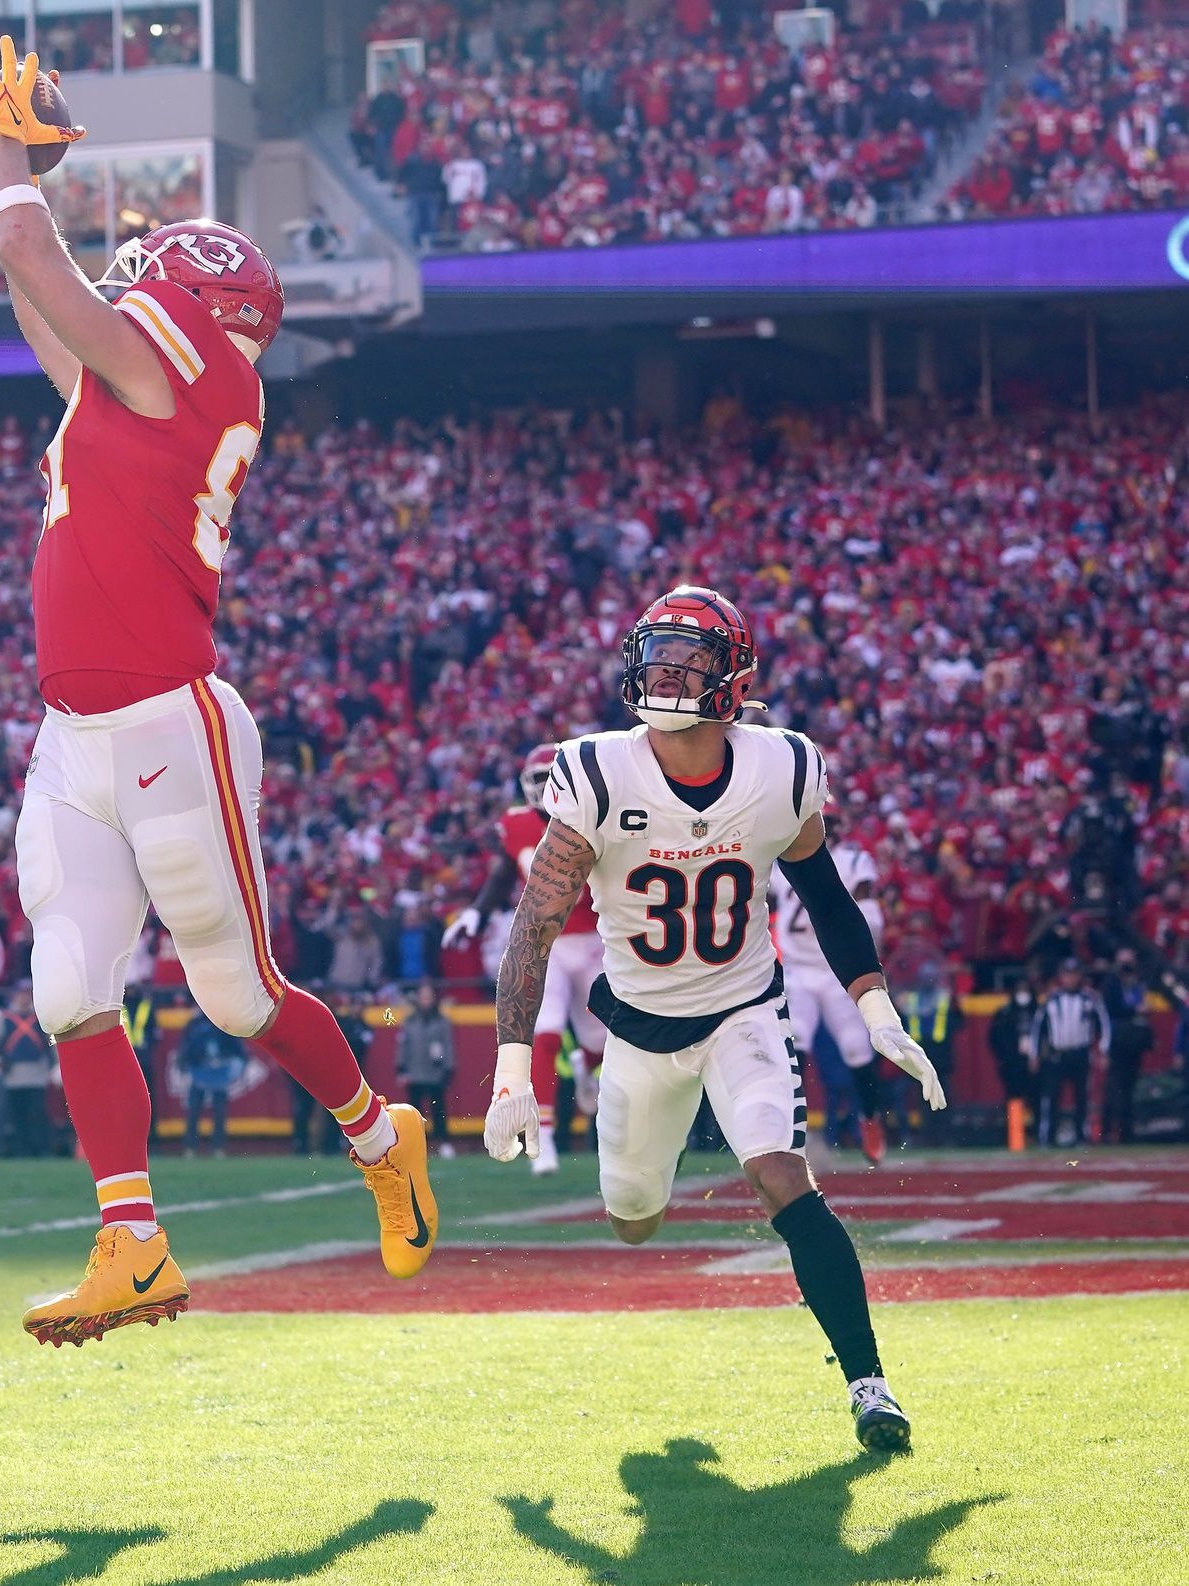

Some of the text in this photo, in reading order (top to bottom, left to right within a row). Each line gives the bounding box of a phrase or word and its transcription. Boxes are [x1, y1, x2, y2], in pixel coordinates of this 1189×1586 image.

[620, 810, 648, 831] C
[649, 843, 742, 860] BENGALS
[626, 858, 754, 967] 30
